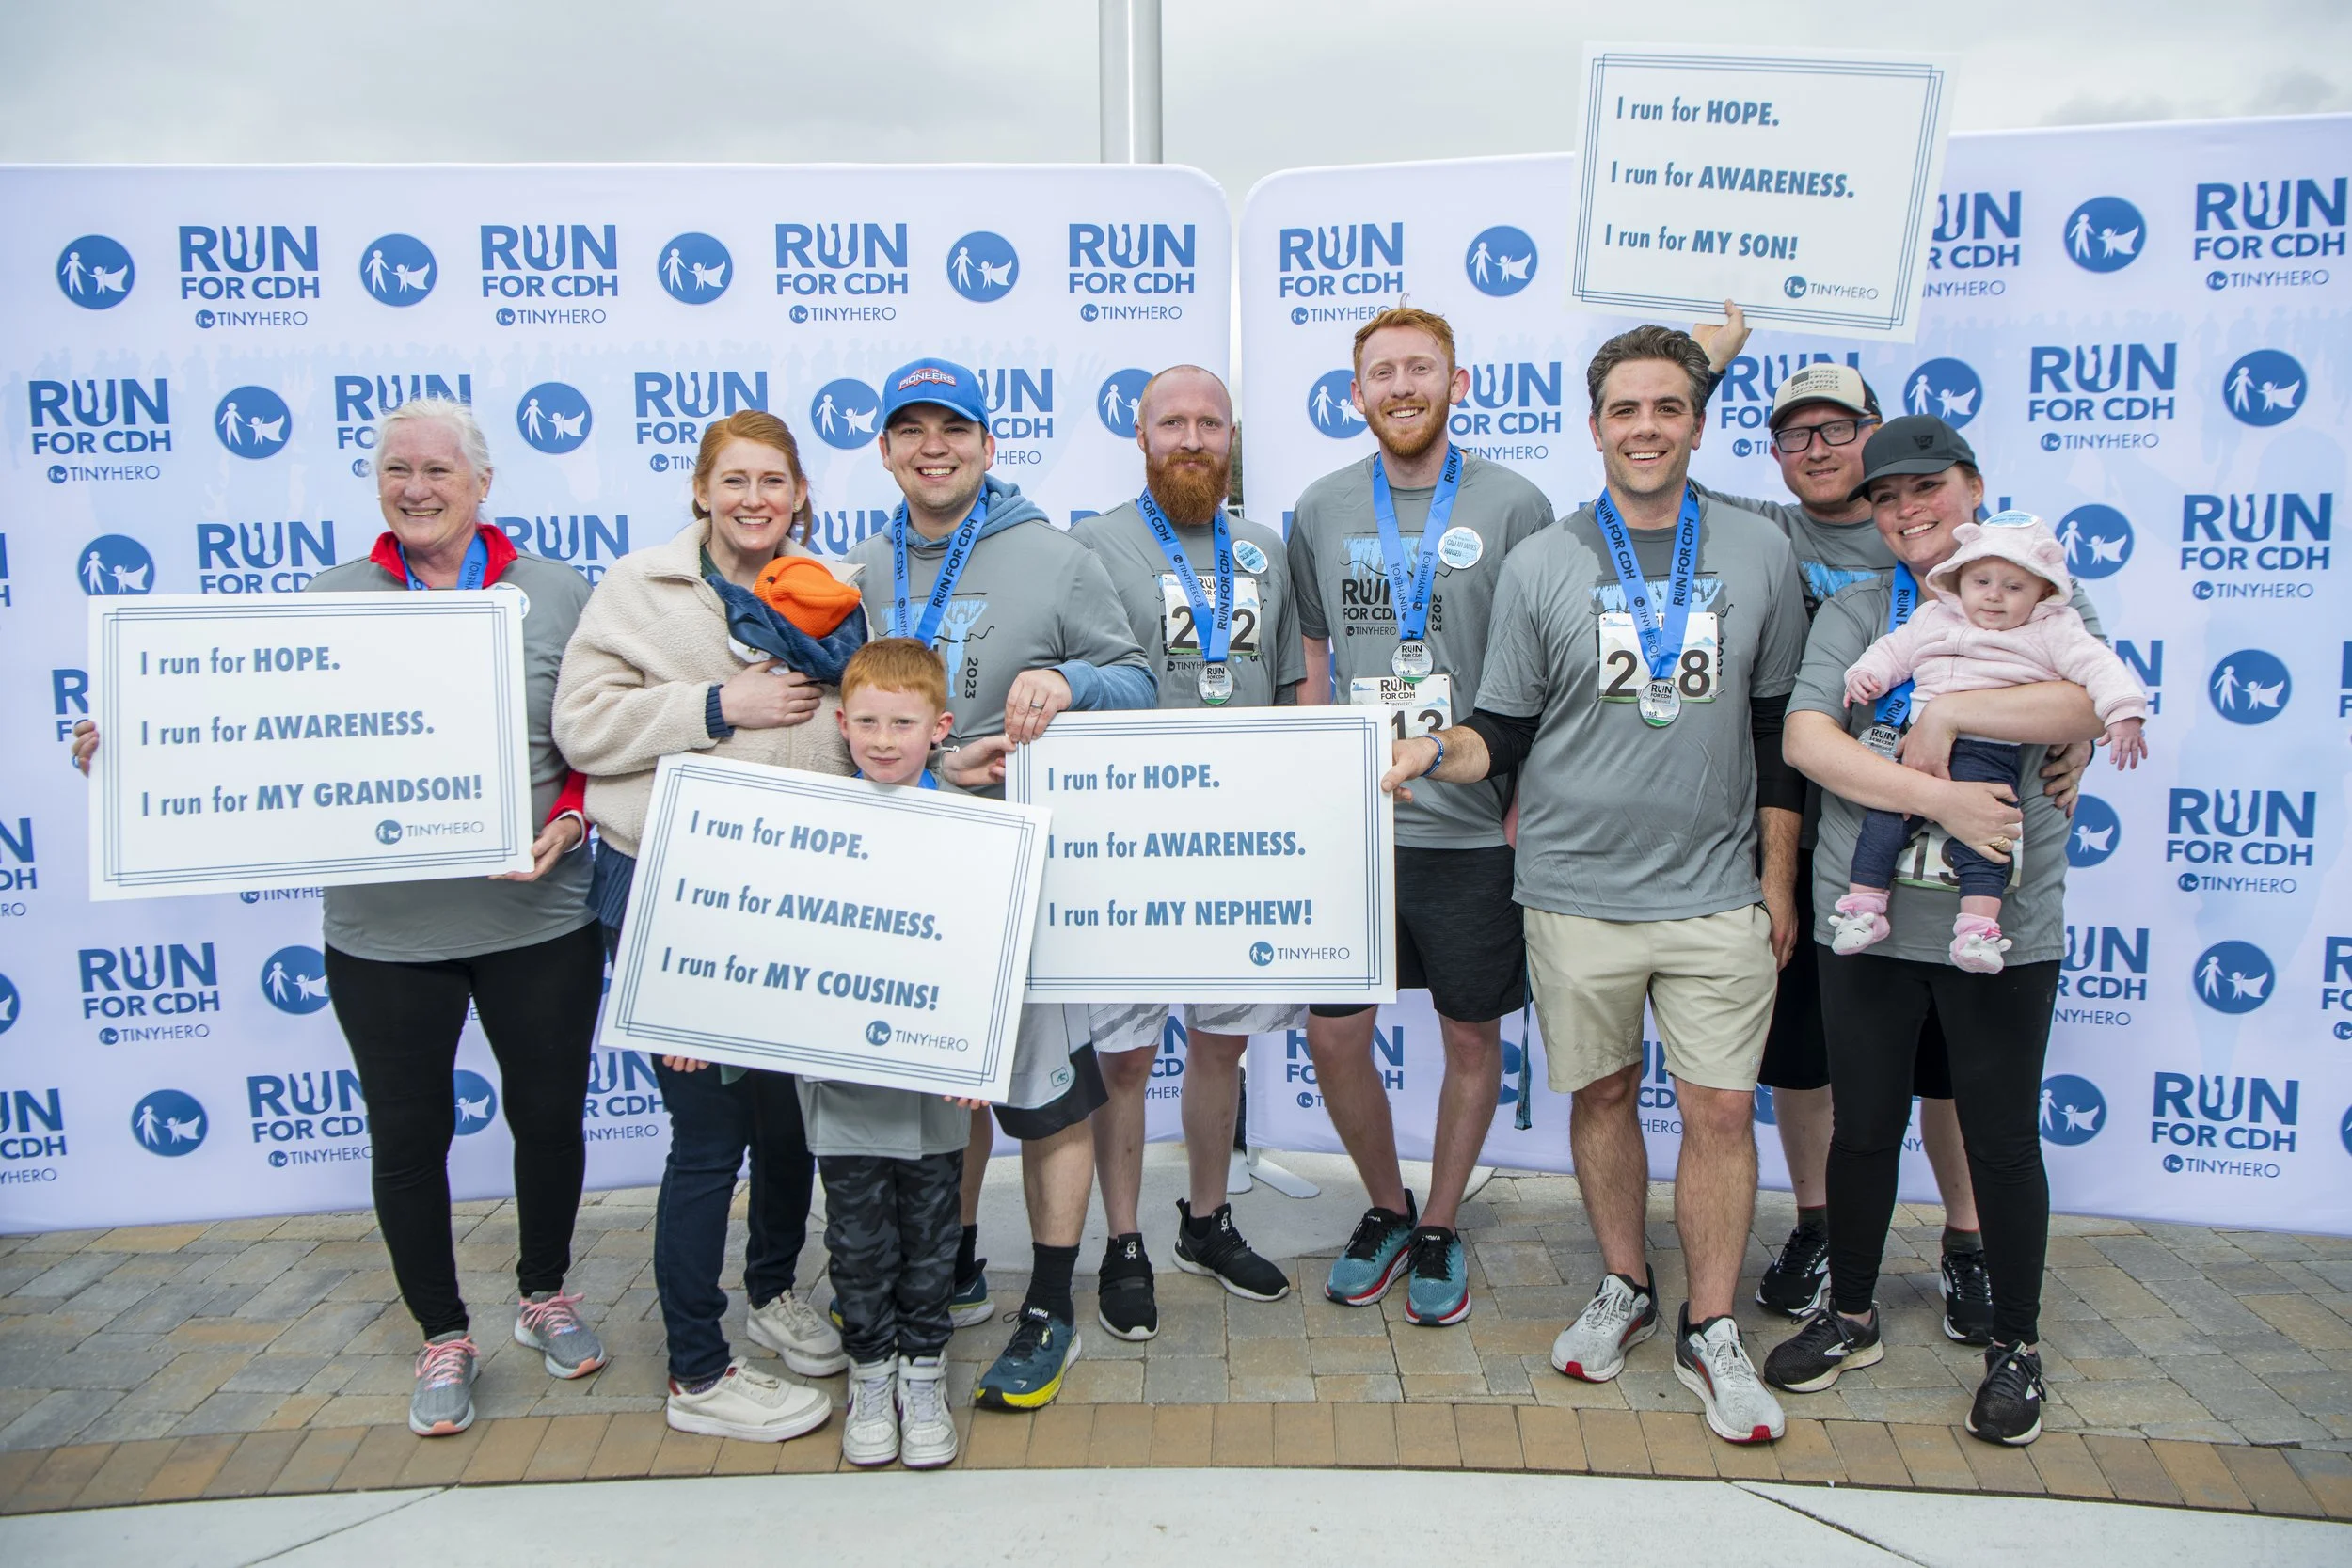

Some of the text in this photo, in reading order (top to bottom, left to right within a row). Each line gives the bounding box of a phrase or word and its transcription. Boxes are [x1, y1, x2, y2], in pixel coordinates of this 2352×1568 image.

[1617, 96, 1779, 126] I run for HOPE.
[1612, 161, 1854, 198] I run for AWARENESS.
[2196, 177, 2348, 231] RUN
[179, 226, 318, 273] RUN
[481, 225, 617, 271] RUN
[775, 223, 907, 269] RUN
[1069, 224, 1195, 268] RUN
[1280, 222, 1404, 272] RUN
[1605, 224, 1798, 260] I run for MY SON!
[2195, 232, 2345, 260] FOR CDH
[1954, 244, 2020, 269] CDH
[181, 277, 319, 299] FOR CDH
[482, 275, 618, 297] FOR CDH
[777, 273, 908, 295] FOR CDH
[1070, 272, 1194, 293] FOR CDH
[1280, 273, 1404, 298] FOR CDH
[1810, 283, 1879, 300] TINYHERO
[1922, 280, 2006, 297] INYHERO
[2231, 269, 2329, 287] TINYHERO
[216, 311, 308, 326] TINYHERO
[517, 309, 606, 324] TINYHERO
[810, 307, 896, 321] TINYHERO
[1101, 306, 1182, 319] TINYHERO
[900, 372, 954, 387] PIONEERS
[2030, 342, 2177, 393] RUN
[28, 378, 169, 427] RUN
[635, 372, 767, 418] RUN
[2029, 397, 2174, 421] FOR CDH
[636, 422, 698, 444] FOR
[991, 418, 1053, 439] CDH
[1500, 412, 1561, 434] CDH
[32, 430, 171, 454] FOR CDH
[2063, 433, 2159, 450] TINYHERO
[69, 466, 160, 481] TINYHERO
[1444, 456, 1457, 483] RUN
[1140, 495, 1170, 541] FOR CDH
[2183, 493, 2333, 542] RUN
[197, 521, 338, 572] RUN
[495, 515, 628, 561] RUN
[1598, 499, 1636, 579] RUN FOR CDH
[933, 519, 977, 608] RUN FOR CDH
[1674, 518, 1694, 606] RUN FOR CDH
[2181, 546, 2330, 570] FOR CDH
[201, 574, 263, 593] FOR
[1181, 564, 1203, 604] TINYHERO
[1217, 549, 1230, 631] RUN FOR CDH
[1392, 568, 1407, 612] TINYHERO
[1416, 555, 1431, 602] TINYHERO
[2217, 583, 2314, 598] TINYHERO
[1343, 608, 1368, 620] FOR
[1432, 595, 1442, 632] 2023
[1896, 590, 1910, 622] RUN
[1172, 606, 1255, 651] 22
[1355, 626, 1396, 636] TINYHERO
[1641, 608, 1658, 654] TINYHERO
[141, 647, 340, 675] I run for HOPE.
[1607, 649, 1710, 697] 28
[965, 658, 977, 699] 2023
[1380, 680, 1415, 692] RUN
[1651, 685, 1672, 693] RUN
[1884, 699, 1905, 728] RUN
[142, 711, 434, 745] I run for AWARENESS.
[1871, 729, 1896, 741] RUN
[1049, 764, 1219, 790] I run for HOPE.
[142, 775, 482, 816] I run for MY GRANDSON!
[2168, 788, 2316, 838] RUN
[405, 821, 484, 837] TINYHERO
[691, 810, 868, 860] I run for HOPE.
[1049, 832, 1305, 858] I run for AWARENESS.
[2167, 840, 2313, 866] FOR CDH
[2201, 876, 2296, 893] TINYHERO
[676, 878, 942, 941] I run for AWARENESS.
[1050, 899, 1311, 926] I run for MY NEPHEW!
[1278, 947, 1350, 959] TINYHERO
[78, 942, 218, 995] RUN
[661, 947, 939, 1011] I run for MY COUSINS!
[2077, 976, 2147, 1000] CDH
[83, 990, 219, 1019] FOR CDH
[120, 1024, 210, 1042] TINYHERO
[895, 1030, 968, 1052] TINYHERO
[246, 1070, 365, 1117] RUN
[606, 1094, 667, 1117] CDH
[2153, 1072, 2299, 1128] RUN
[252, 1120, 312, 1143] FOR
[584, 1124, 659, 1142] INYHERO
[2152, 1122, 2296, 1152] FOR CDH
[2185, 1158, 2280, 1178] TINYHERO
[1028, 1307, 1049, 1319] HOKA
